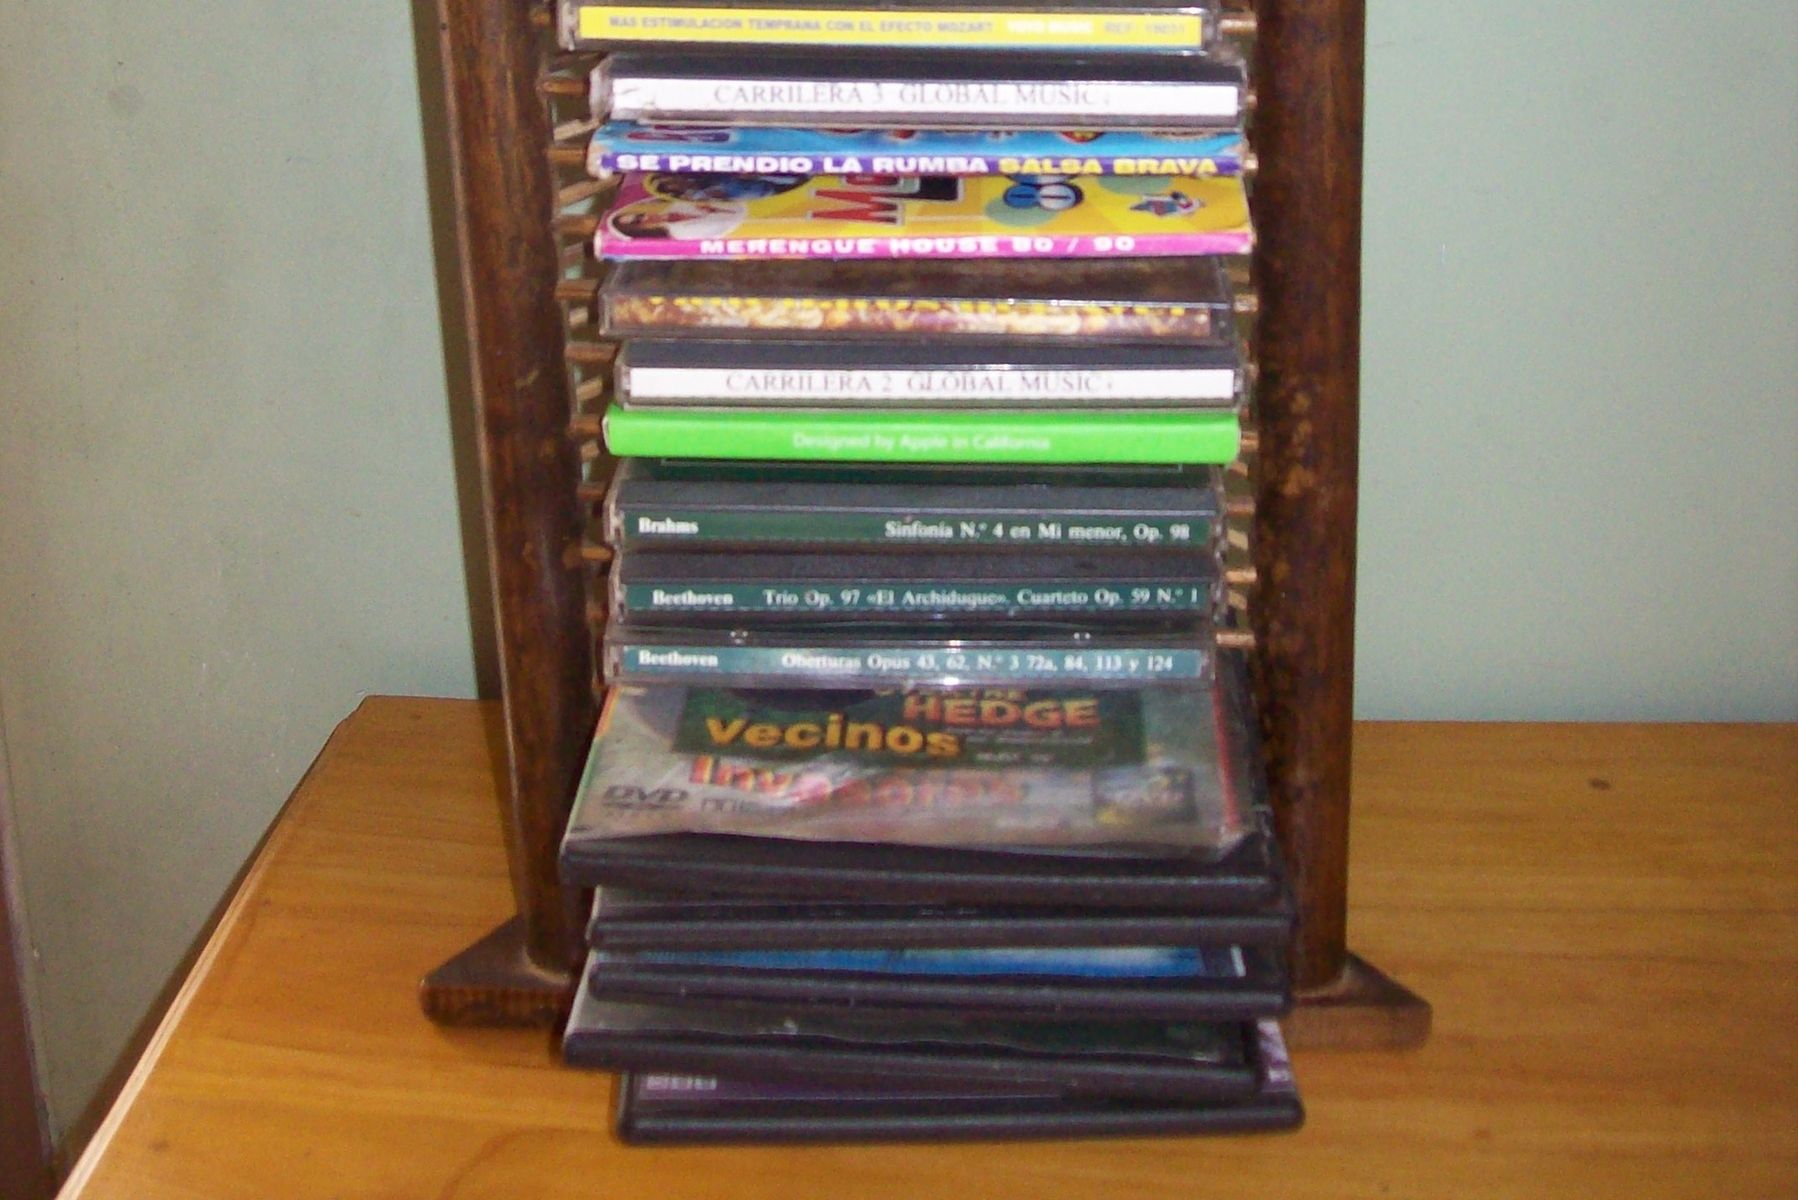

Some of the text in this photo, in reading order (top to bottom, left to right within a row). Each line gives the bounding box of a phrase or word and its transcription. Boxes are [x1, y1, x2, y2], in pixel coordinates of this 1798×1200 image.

[748, 18, 820, 31] TEMPRANA
[826, 20, 854, 32] CON
[859, 21, 875, 32] EL
[880, 21, 932, 33] EFECTO
[714, 84, 864, 104] CARRILERA
[899, 84, 1008, 105] GLOBAL
[617, 154, 1219, 175] SE PRENDIO LA RUMBA SALSA BRAVA
[700, 239, 876, 254] MERENGUE
[889, 238, 999, 254] HOUSE
[1065, 237, 1079, 253] /
[1092, 236, 1136, 252] 90
[726, 374, 872, 393] CARRILERA
[881, 374, 894, 392] 2
[906, 373, 1015, 393] GLOBAL
[792, 432, 1051, 453] Designed by Apple in California
[638, 516, 700, 535] Brahms
[993, 522, 1004, 538] 4
[1009, 524, 1031, 539] en
[1038, 522, 1062, 539] Mi
[1169, 523, 1191, 539] 98
[652, 589, 734, 607] Beethoven
[840, 589, 861, 606] 97
[1016, 588, 1089, 606] Cuarteto
[1190, 588, 1198, 603] 1
[638, 649, 719, 667] Beethoven
[782, 653, 862, 670] Oberturas
[867, 654, 911, 672] Opus
[1095, 655, 1123, 672] 113
[1128, 657, 1141, 674] y
[1147, 655, 1174, 672] 124
[903, 694, 1098, 729] HEDGE
